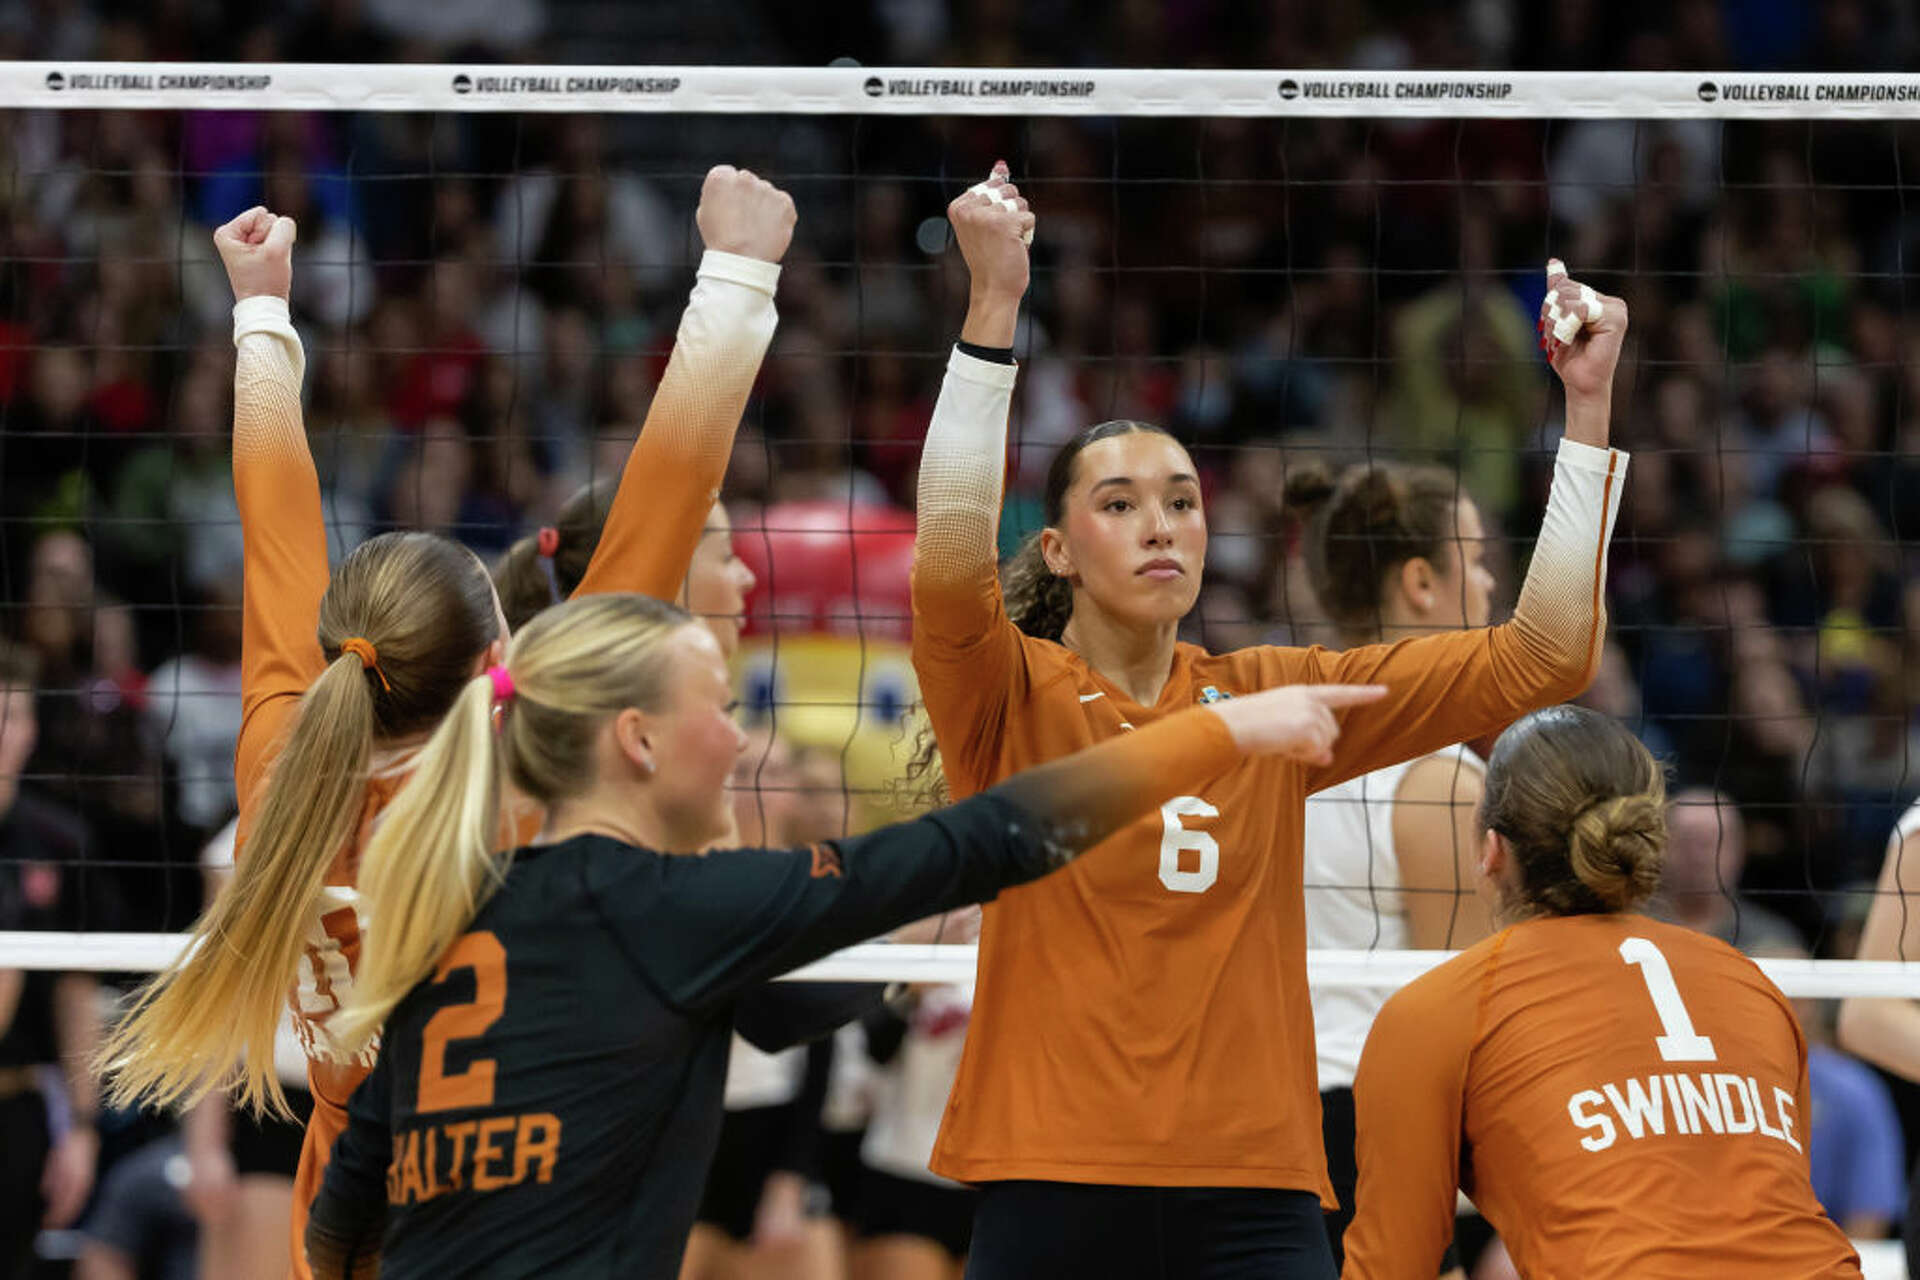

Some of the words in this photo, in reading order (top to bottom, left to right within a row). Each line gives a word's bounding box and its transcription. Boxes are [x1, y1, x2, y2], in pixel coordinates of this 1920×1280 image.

[71, 75, 152, 89] VOLLEYBALL
[160, 76, 271, 90] CHAMPIONSHIP
[476, 78, 560, 93] VOLLEYBALL
[567, 78, 681, 93] CHAMPIONSHIP
[889, 80, 973, 96] VOLLEYBALL
[980, 81, 1095, 97] CHAMPIONSHIP
[1304, 83, 1389, 98] VOLLEYBALL
[1395, 83, 1512, 99] CHAMPIONSHIP
[1722, 85, 1810, 101] VOLLEYBALL
[1158, 796, 1220, 893] 6
[1618, 937, 1718, 1061] 1
[416, 930, 507, 1113] 2
[1568, 1073, 1803, 1154] SWINDLE
